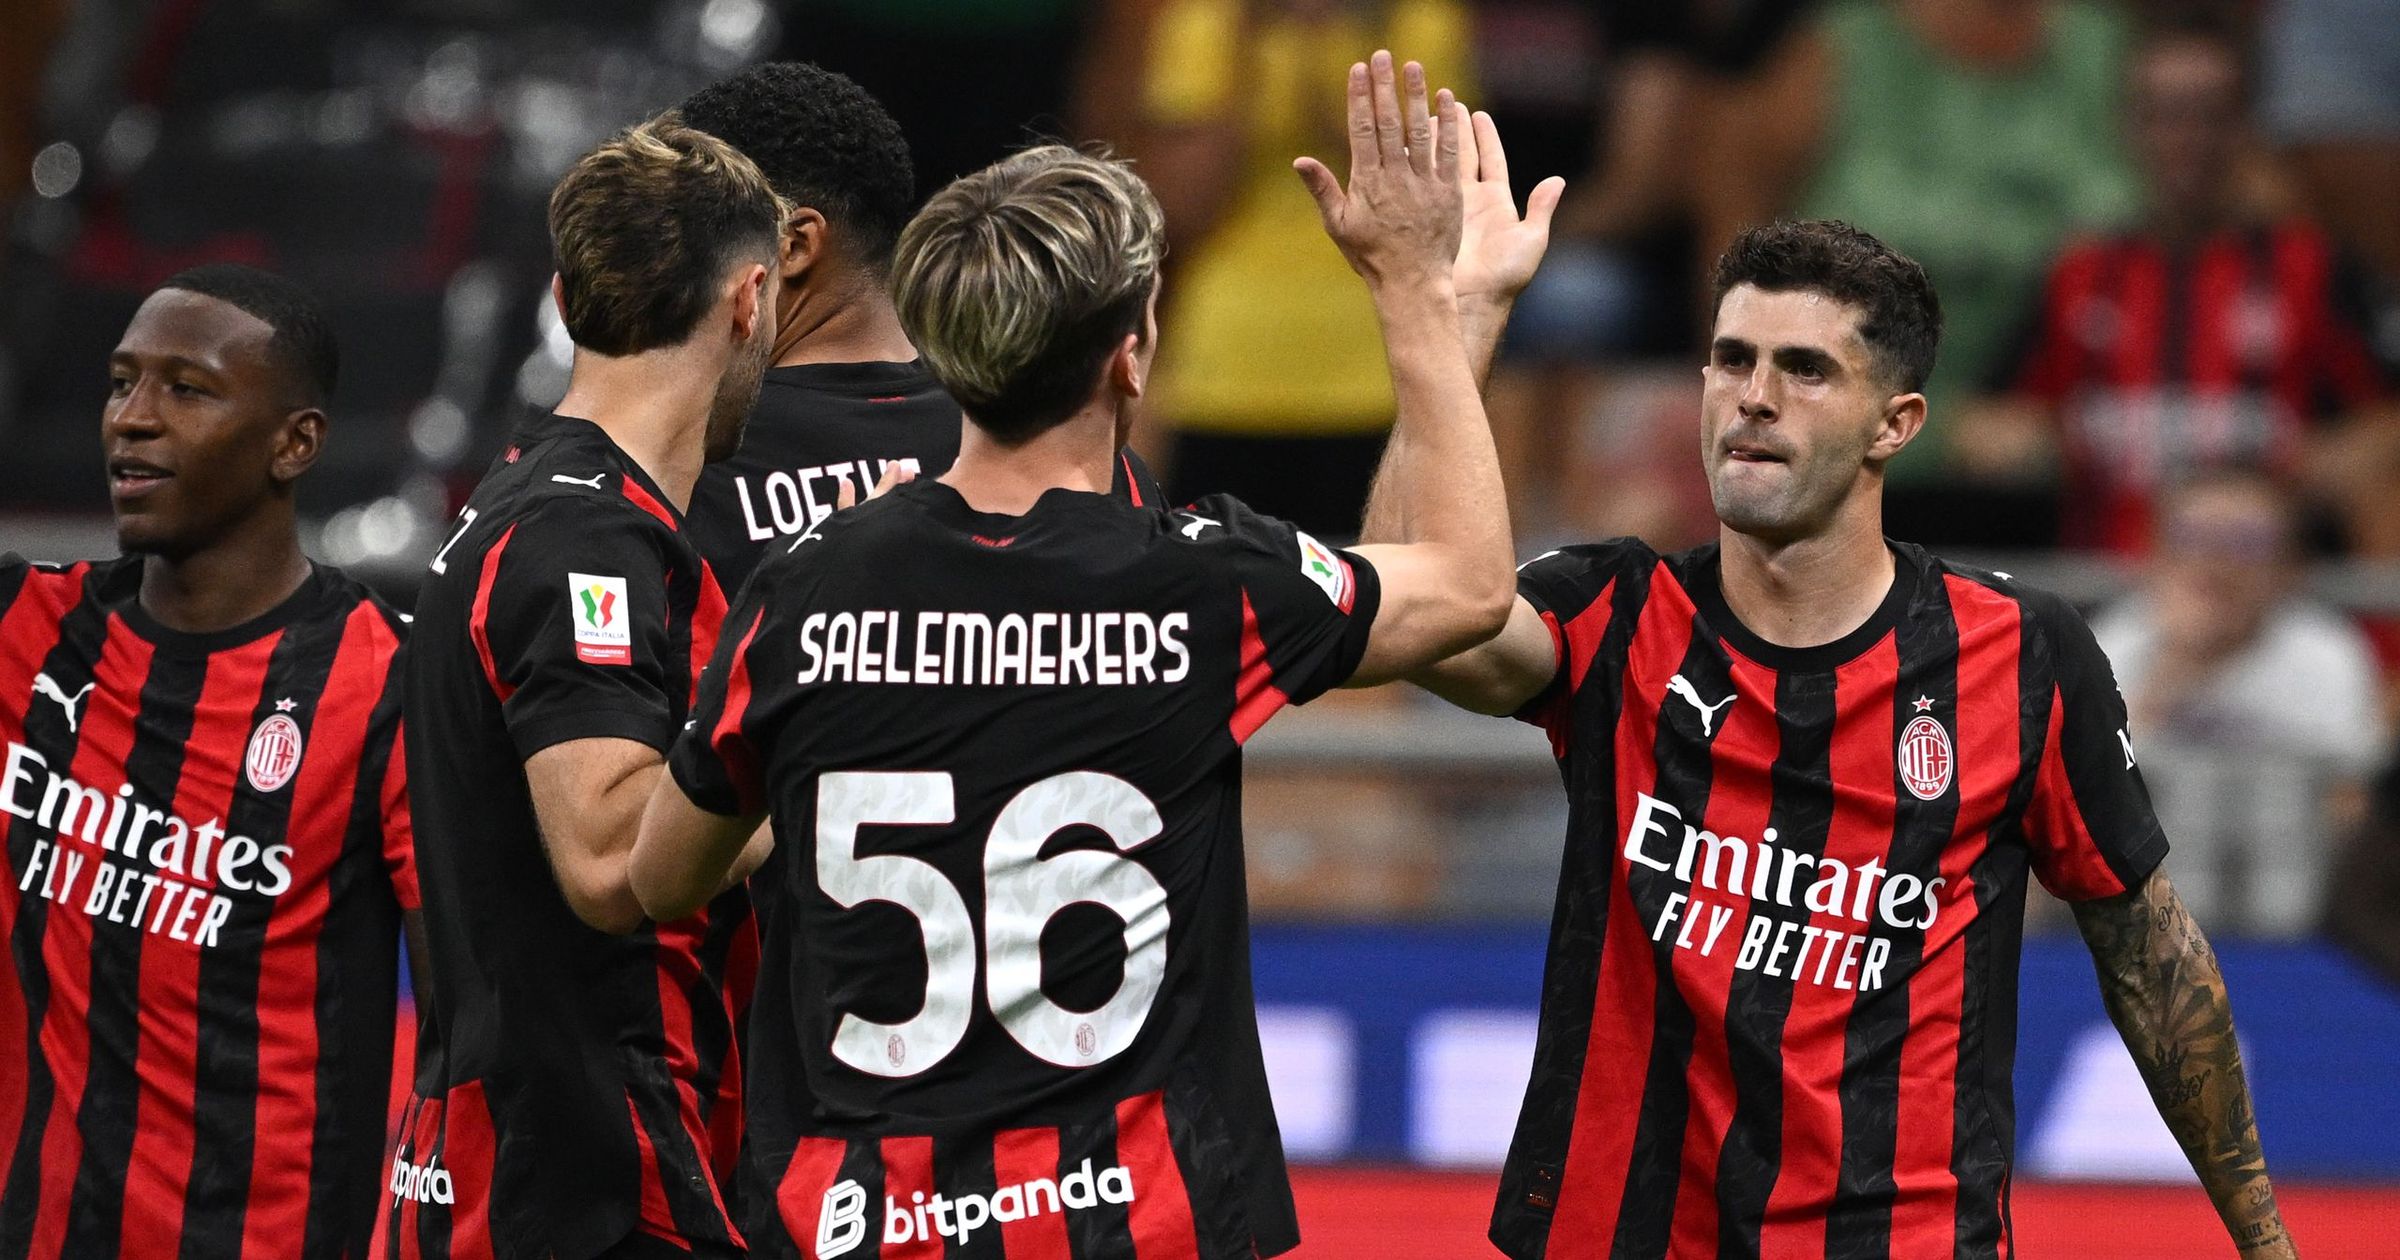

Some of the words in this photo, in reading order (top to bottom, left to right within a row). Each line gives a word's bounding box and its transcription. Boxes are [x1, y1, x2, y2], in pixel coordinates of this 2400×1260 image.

[734, 458, 921, 541] LOFT
[797, 611, 1190, 685] SAELEMAEKERS
[1910, 723, 1939, 739] ACM
[0, 741, 293, 897] Emirates
[1914, 780, 1940, 791] 1899
[19, 839, 84, 905] FLY
[83, 861, 232, 947] BETTER
[1623, 791, 1946, 930] Emirates
[816, 770, 1171, 1077] 56
[1652, 892, 1734, 957] FLY
[1735, 914, 1891, 991] BETTER
[883, 1157, 1135, 1246] bitpanda
